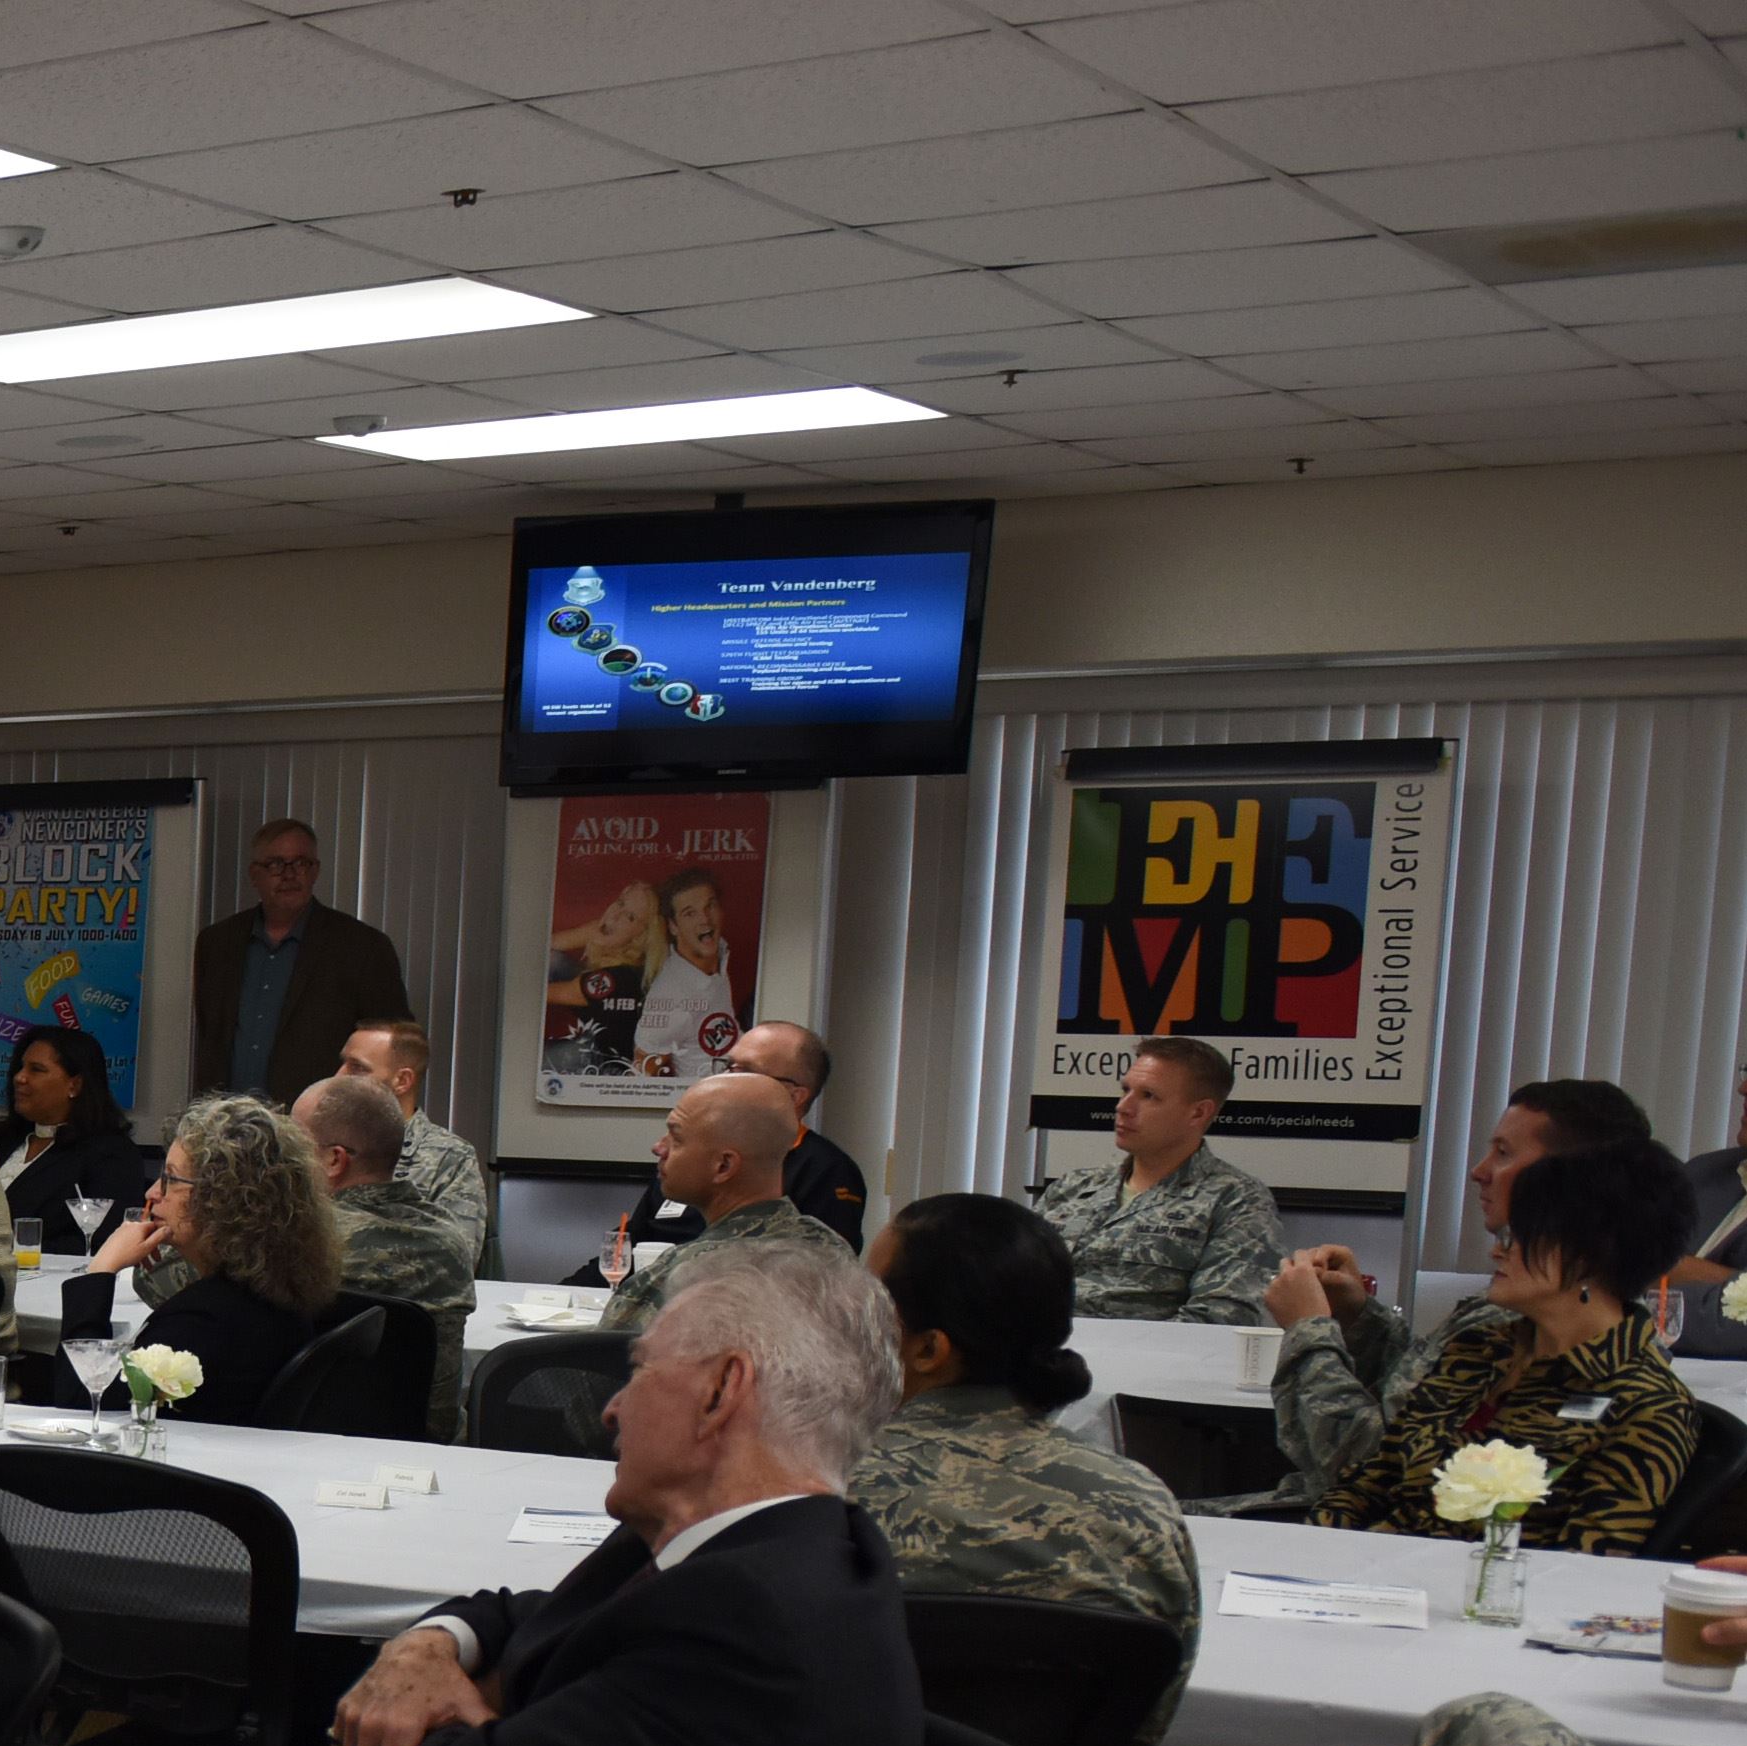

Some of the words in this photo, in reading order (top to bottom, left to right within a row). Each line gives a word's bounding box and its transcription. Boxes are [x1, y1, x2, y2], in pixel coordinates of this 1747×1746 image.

[717, 581, 765, 594] Team
[771, 579, 877, 593] Vandenberg
[23, 808, 147, 820] VANDENBERG
[21, 819, 147, 842] NEWCOMER'S
[571, 816, 660, 841] AVOID
[1380, 782, 1424, 891] Service
[568, 843, 627, 856] FALLING
[631, 842, 658, 855] FOR
[664, 844, 673, 854] A
[678, 828, 756, 857] JERK
[30, 930, 41, 941] 18
[46, 930, 74, 941] JULY
[78, 930, 137, 942] 1000-1400
[28, 955, 76, 1000] FOOD
[81, 987, 130, 1013] GAMES
[602, 999, 616, 1011] 14
[617, 998, 636, 1011] FEB
[1366, 908, 1415, 1081] Exceptional
[1053, 1044, 1134, 1077] Excep
[1230, 1047, 1354, 1081] Families
